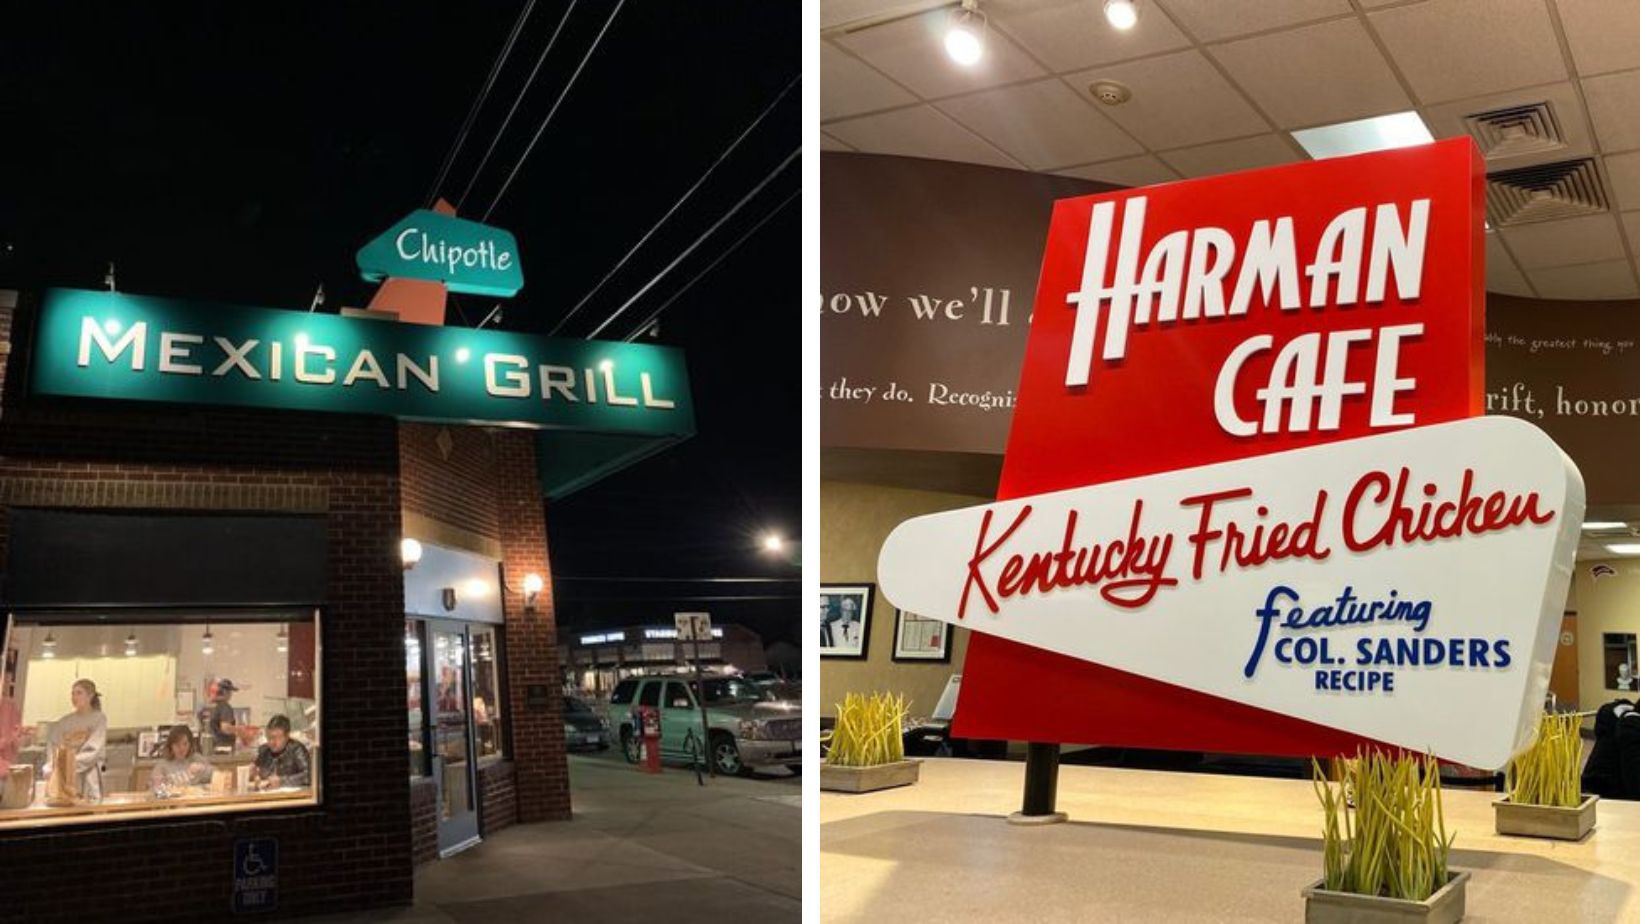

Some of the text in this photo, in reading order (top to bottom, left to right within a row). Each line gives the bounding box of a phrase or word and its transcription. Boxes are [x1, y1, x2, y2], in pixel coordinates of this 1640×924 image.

[396, 228, 512, 274] Chipotle
[908, 286, 1011, 325] we'll
[1065, 195, 1431, 387] HARMAN
[76, 315, 675, 409] MEXICAN GRILL
[1530, 339, 1577, 352] greatest
[1583, 339, 1613, 355] thing
[829, 377, 877, 403] they
[882, 382, 914, 402] do.
[1213, 323, 1425, 437] CAFE
[1486, 382, 1545, 419] rift,
[958, 466, 1556, 619] Kentucky Fried Chicken
[1244, 585, 1432, 677] featuring
[1275, 636, 1512, 669] COL. SANDERS
[1315, 669, 1395, 693] RECIPE
